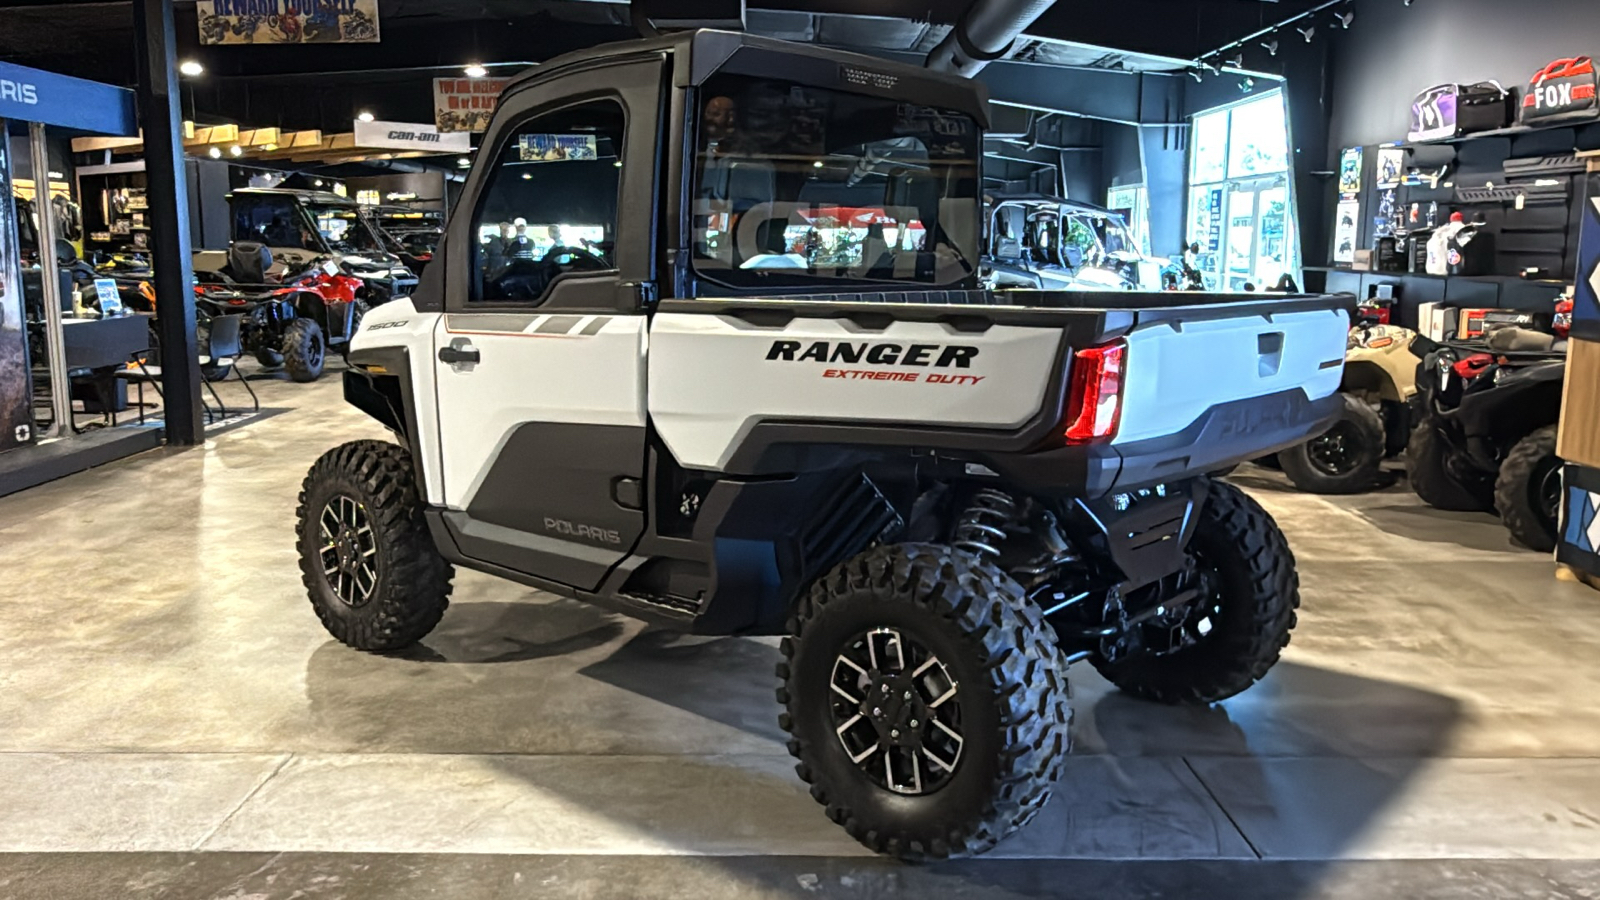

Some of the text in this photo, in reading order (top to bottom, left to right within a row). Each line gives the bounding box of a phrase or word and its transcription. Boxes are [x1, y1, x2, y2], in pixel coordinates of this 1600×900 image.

[0, 80, 38, 105] RIS
[1534, 83, 1572, 109] FOX
[387, 130, 440, 142] can-am
[367, 320, 409, 331] 1500
[765, 340, 979, 368] RANGER
[822, 369, 987, 386] EXTREME DUTY
[543, 517, 621, 544] POLARIS
